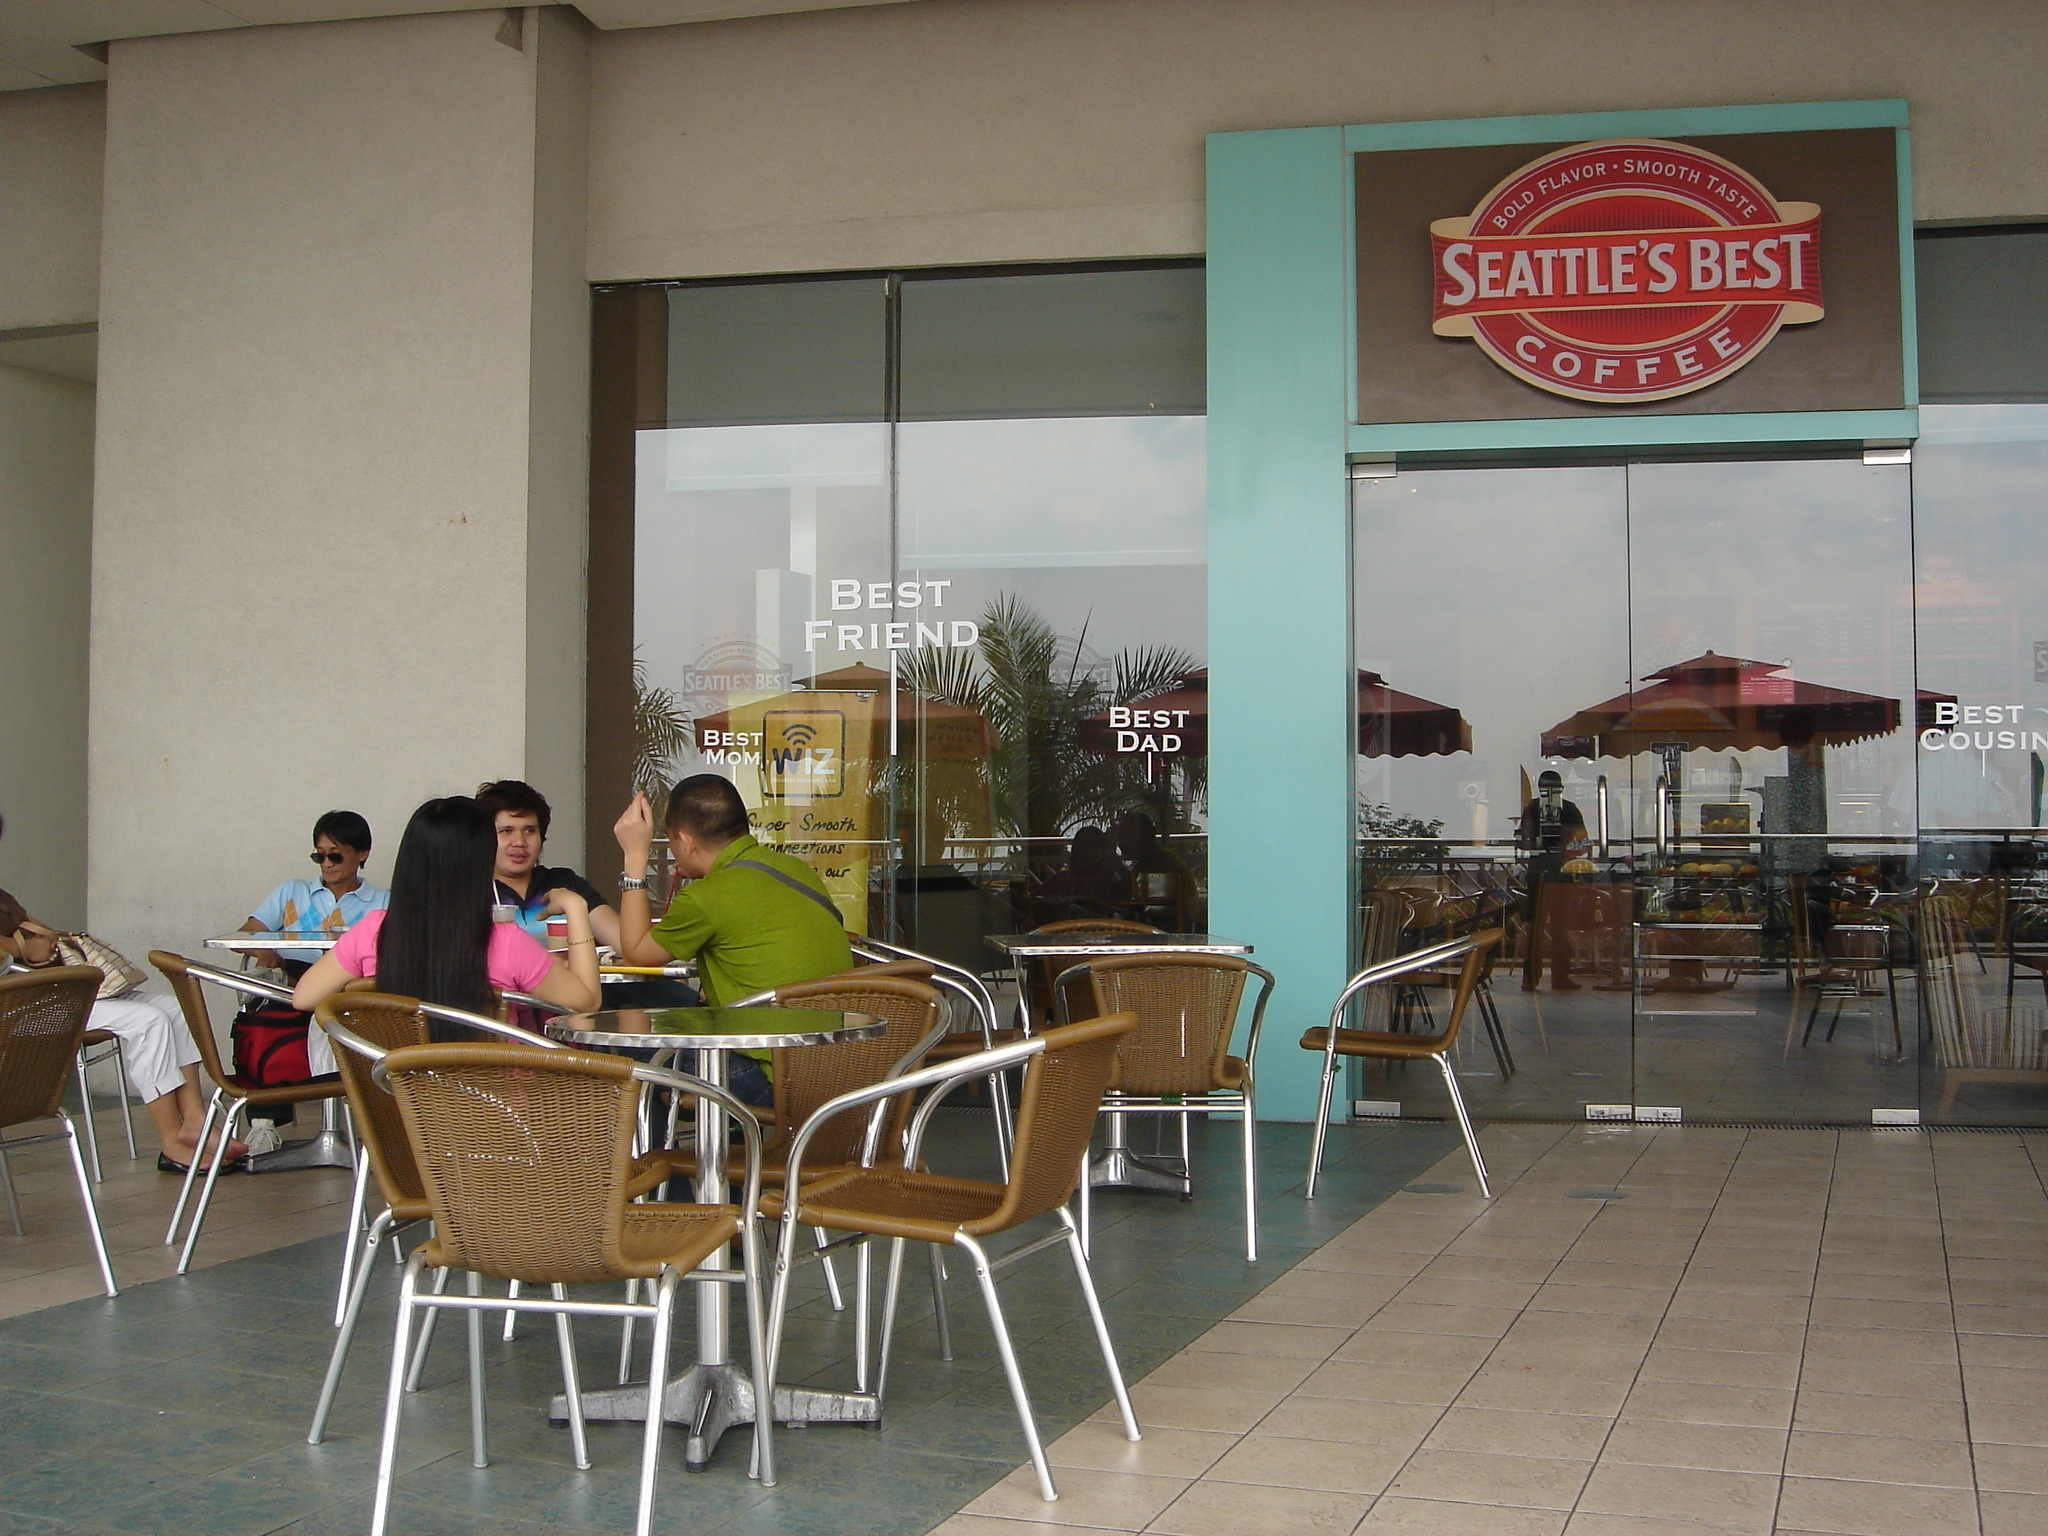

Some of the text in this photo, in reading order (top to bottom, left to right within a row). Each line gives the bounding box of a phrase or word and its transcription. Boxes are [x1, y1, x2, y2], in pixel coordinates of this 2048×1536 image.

[1492, 159, 1757, 229] BOLD FLAVOR SMOOTH TASTE
[1442, 233, 1811, 306] SEATTLE'S BEST
[1516, 326, 1741, 384] COFFEE
[831, 579, 951, 611] BEST
[803, 620, 979, 652] FRIEND
[1109, 706, 1190, 729] BEST
[1935, 702, 2024, 725] BEST
[703, 729, 764, 746] BEST
[1117, 731, 1182, 753] DAD
[706, 748, 760, 765] MOM
[772, 747, 835, 775] WIZ
[800, 812, 857, 832] Smooth
[825, 867, 851, 878] our
